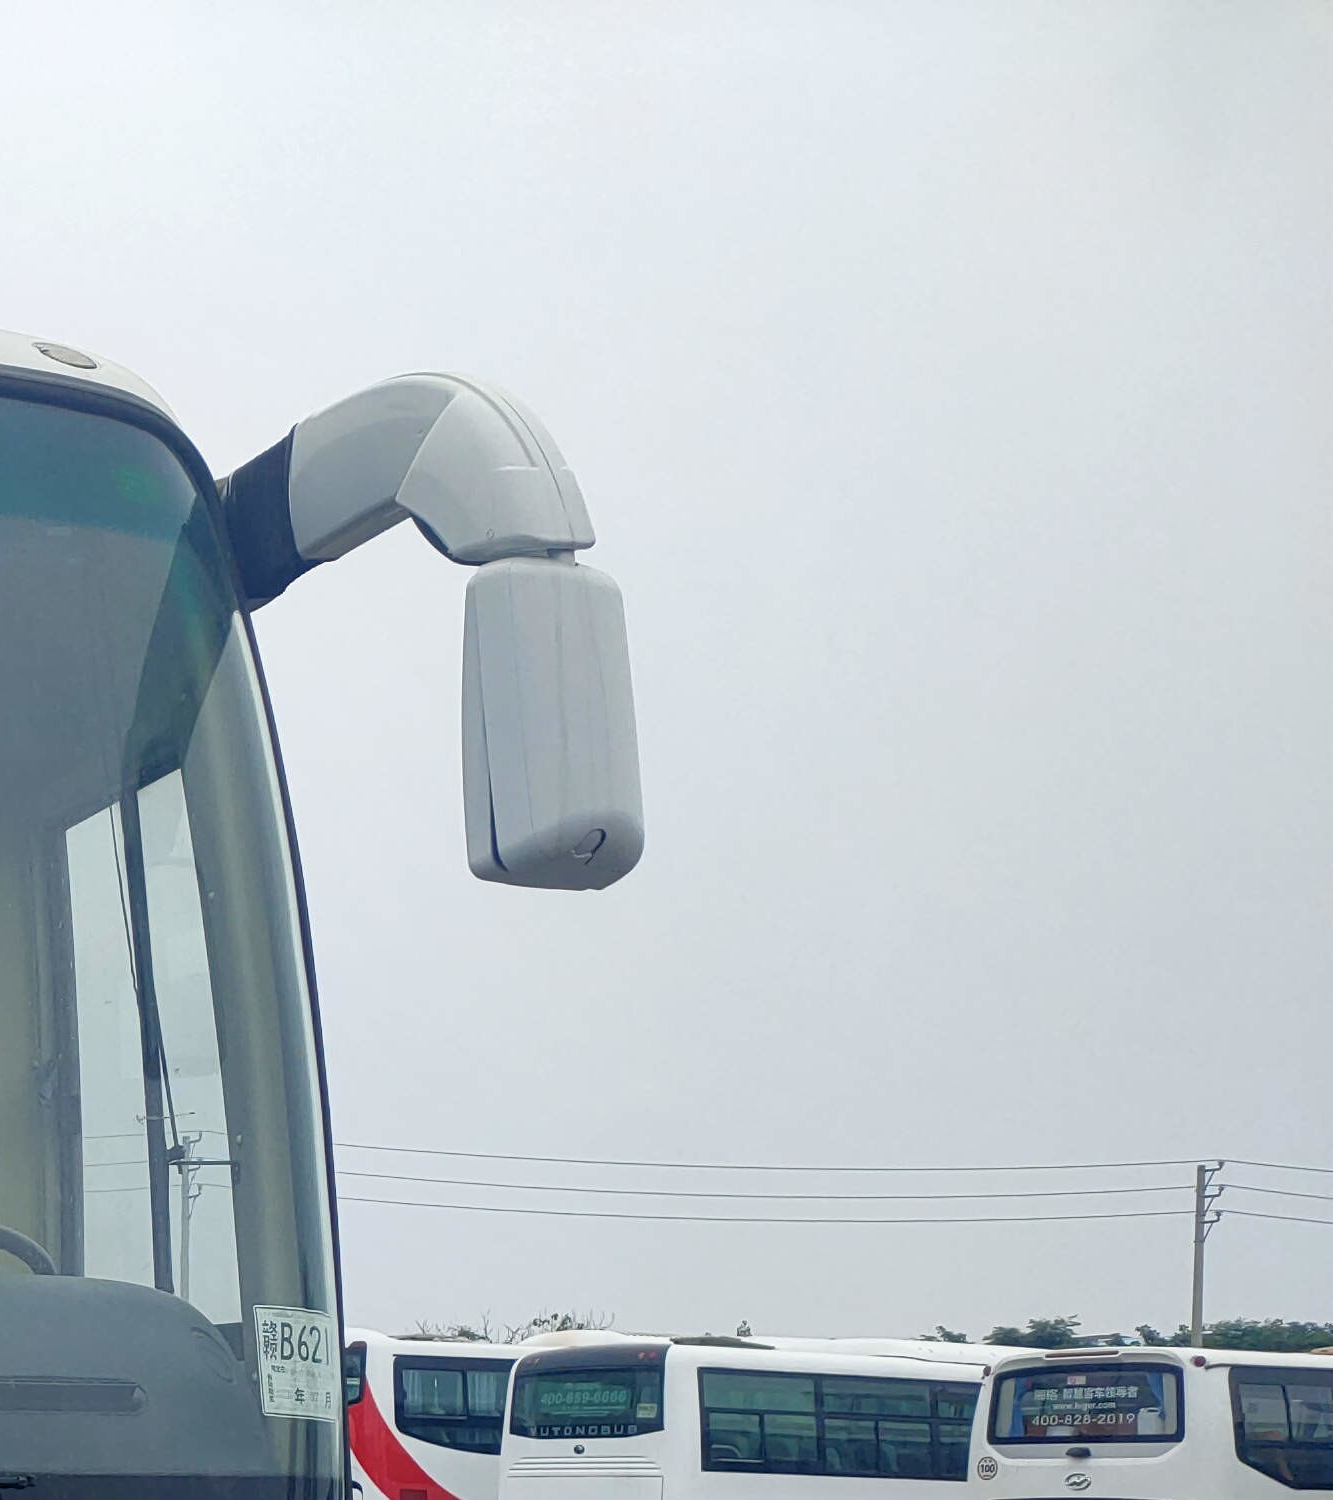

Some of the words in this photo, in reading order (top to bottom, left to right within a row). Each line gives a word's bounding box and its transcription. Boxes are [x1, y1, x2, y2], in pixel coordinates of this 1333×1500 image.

[294, 1387, 306, 1405] 年
[1032, 1413, 1136, 1427] 400-828-2019
[980, 1463, 996, 1474] 100
